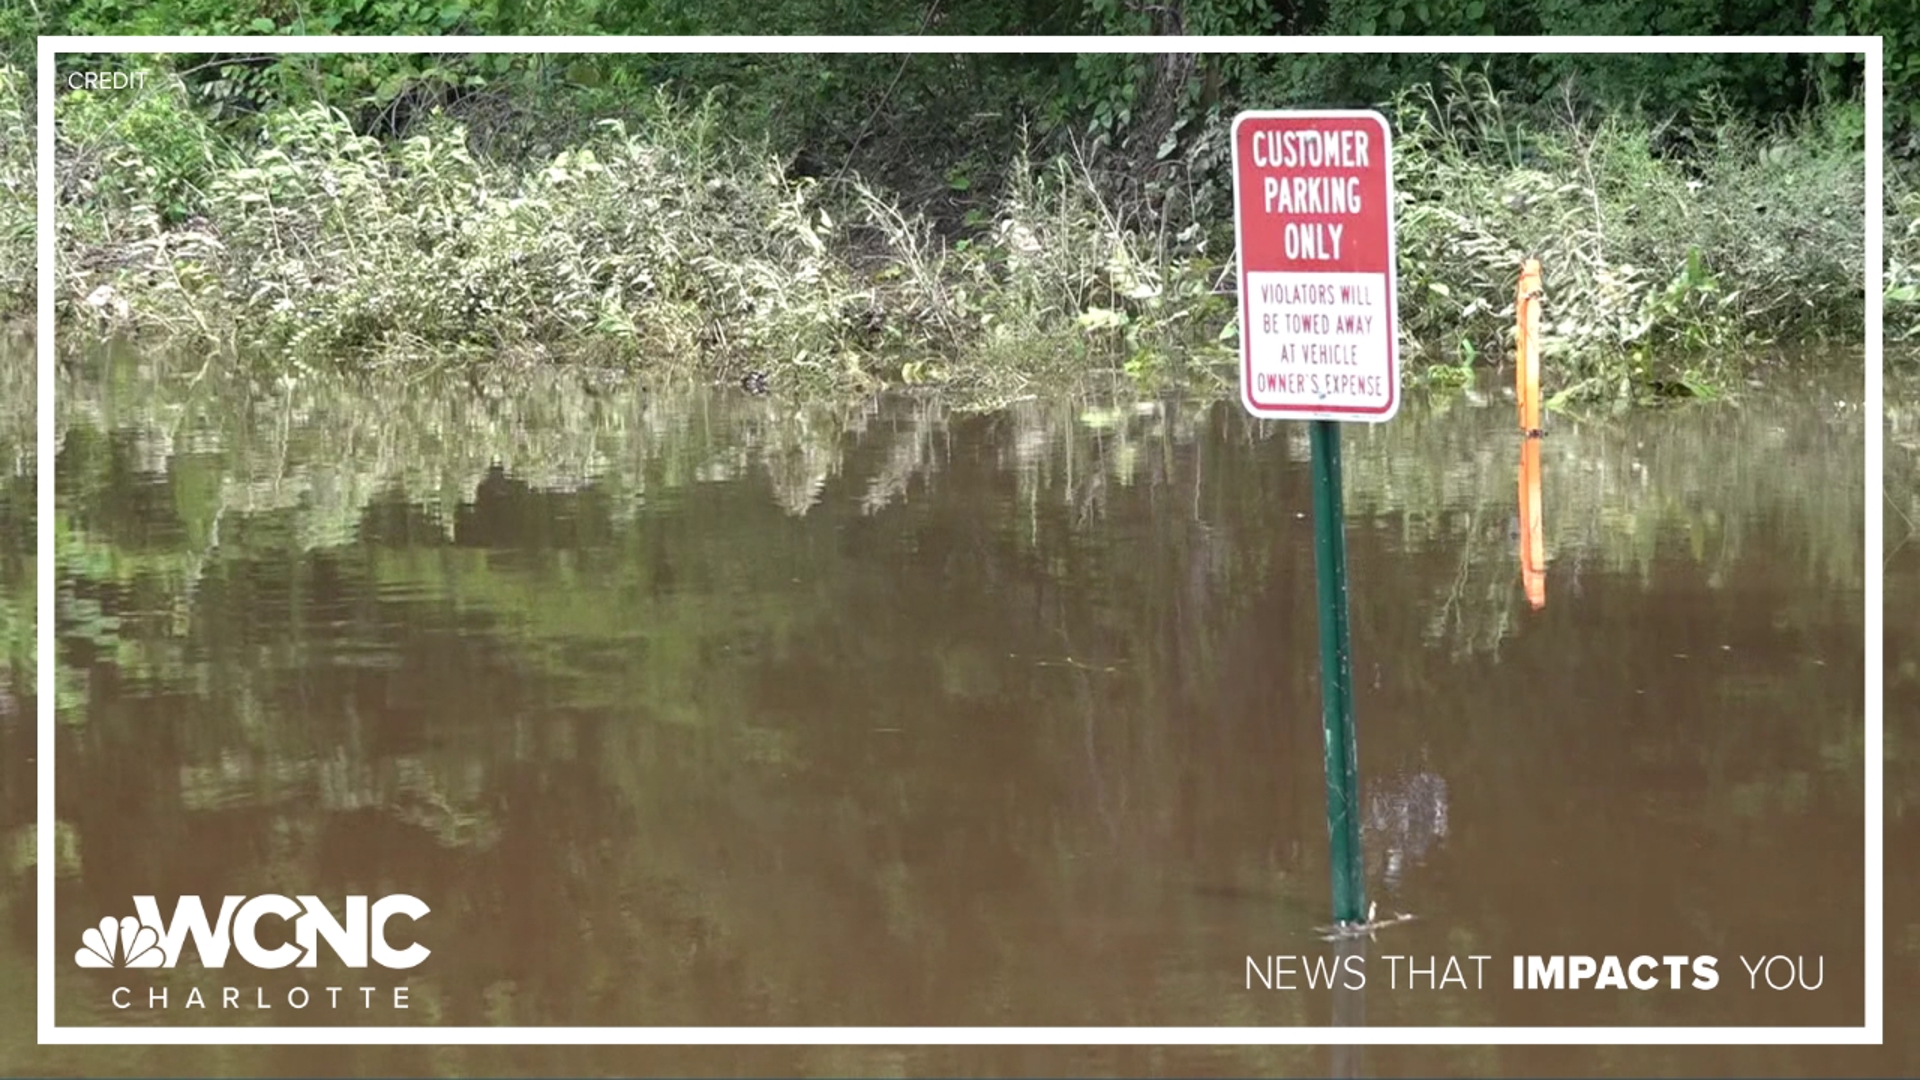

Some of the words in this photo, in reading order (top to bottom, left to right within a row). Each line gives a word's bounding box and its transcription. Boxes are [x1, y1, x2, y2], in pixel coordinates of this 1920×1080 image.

[1253, 130, 1369, 168] CUSTOMER
[1264, 177, 1361, 214] PARKING
[1284, 224, 1343, 260] ONLY
[1261, 283, 1335, 306] VIOLATORS
[1340, 285, 1372, 306] WILL
[1263, 314, 1278, 334] BE
[1286, 314, 1330, 335] TOWED
[1336, 315, 1373, 335] AWAY
[1281, 343, 1295, 364] AT
[1302, 344, 1358, 365] VEHICLE
[1257, 373, 1319, 394] OWNER'S
[1326, 374, 1382, 397] EXPENSE
